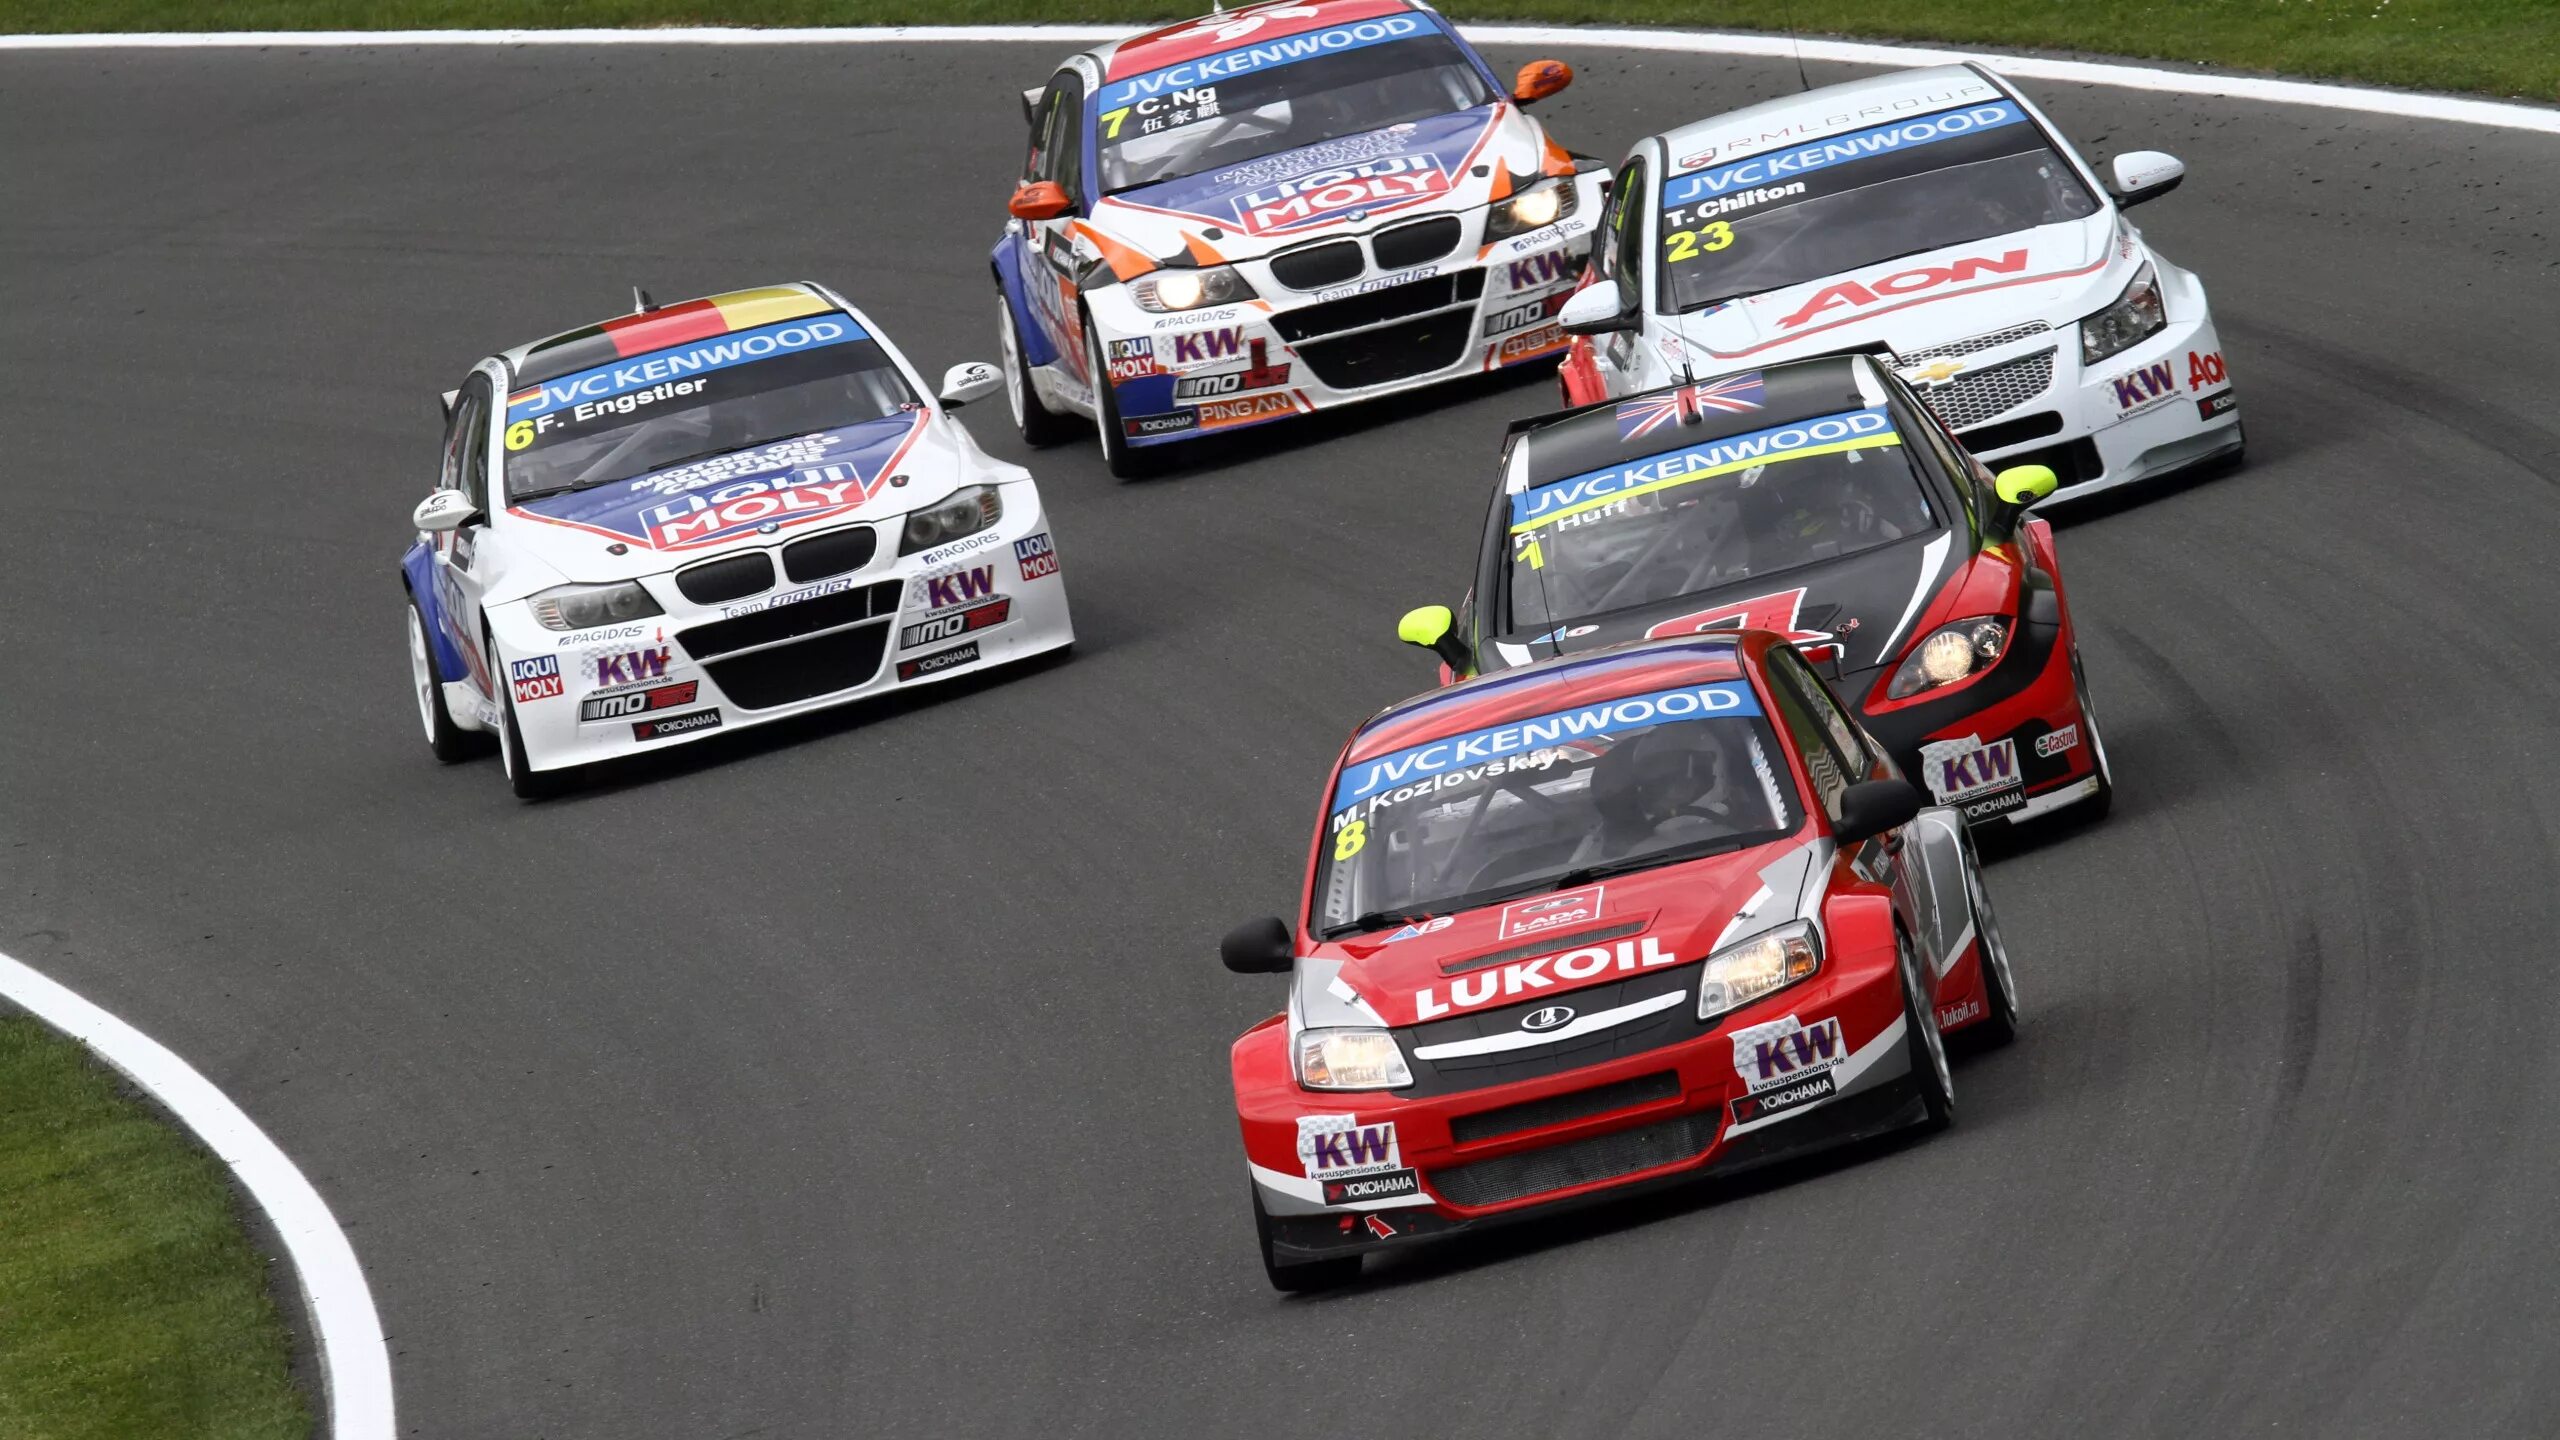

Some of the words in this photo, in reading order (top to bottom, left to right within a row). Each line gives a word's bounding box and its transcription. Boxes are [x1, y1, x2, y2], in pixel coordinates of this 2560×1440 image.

[1117, 66, 1194, 102] JVC
[1198, 18, 1416, 80] KENWOOD
[1101, 107, 1130, 140] 7
[1678, 163, 1762, 200] JVC
[1768, 106, 2008, 177] KENWOOD
[1246, 155, 1430, 208] LIQUI
[1253, 170, 1438, 229] MOLY
[1665, 220, 1735, 263] 23
[1508, 247, 1569, 291] KW
[1774, 248, 2029, 330] AON
[1313, 286, 1355, 304] Team
[1109, 337, 1151, 360] LIQUI
[1174, 323, 1244, 364] KW
[528, 373, 608, 412] JVC
[612, 322, 844, 388] KENWOOD
[1111, 356, 1154, 379] MOLY
[2112, 360, 2174, 410] KW
[535, 413, 564, 434] F.
[573, 378, 708, 422] Engstler
[504, 420, 535, 451] 6
[631, 451, 756, 492] MOTOR
[766, 435, 843, 454] OILS
[653, 445, 828, 492] ADDITIVES
[663, 470, 734, 496] CAR
[736, 452, 825, 475] CARE
[1526, 474, 1617, 516] JVC
[1623, 413, 1888, 489] KENWOOD
[653, 466, 846, 524] LIQUI
[662, 481, 854, 545] MOLY
[1557, 500, 1629, 532] Huff
[1021, 552, 1058, 580] MOLY
[1517, 541, 1544, 571] 1
[927, 564, 994, 609] KW
[720, 601, 764, 621] Team
[512, 655, 558, 682] LIQUI
[597, 644, 671, 687] KW
[917, 647, 977, 672] YOKOHAMA
[515, 676, 563, 702] MOLY
[591, 675, 673, 697] kwsuspensions.de
[655, 712, 719, 735] YOKOHAMA
[1354, 745, 1448, 796] JVC
[1455, 689, 1741, 762] KENWOOD
[2048, 729, 2077, 752] Castrol
[1942, 740, 2013, 792] KW
[1939, 776, 2019, 805] kwsuspensions.de
[1964, 791, 2023, 819] YOKOHAMA
[1334, 820, 1366, 861] 8
[1512, 907, 1589, 931] LADA
[1415, 936, 1676, 1021] LUKOIL
[1754, 1019, 1838, 1080] KW
[1751, 1057, 1845, 1092] kwsuspensions.de
[1760, 1079, 1832, 1110] YOKOHAMA
[1313, 1125, 1394, 1169] KW
[1310, 1162, 1397, 1180] kwsuspensions.de
[1344, 1176, 1415, 1197] YOKOHAMA
